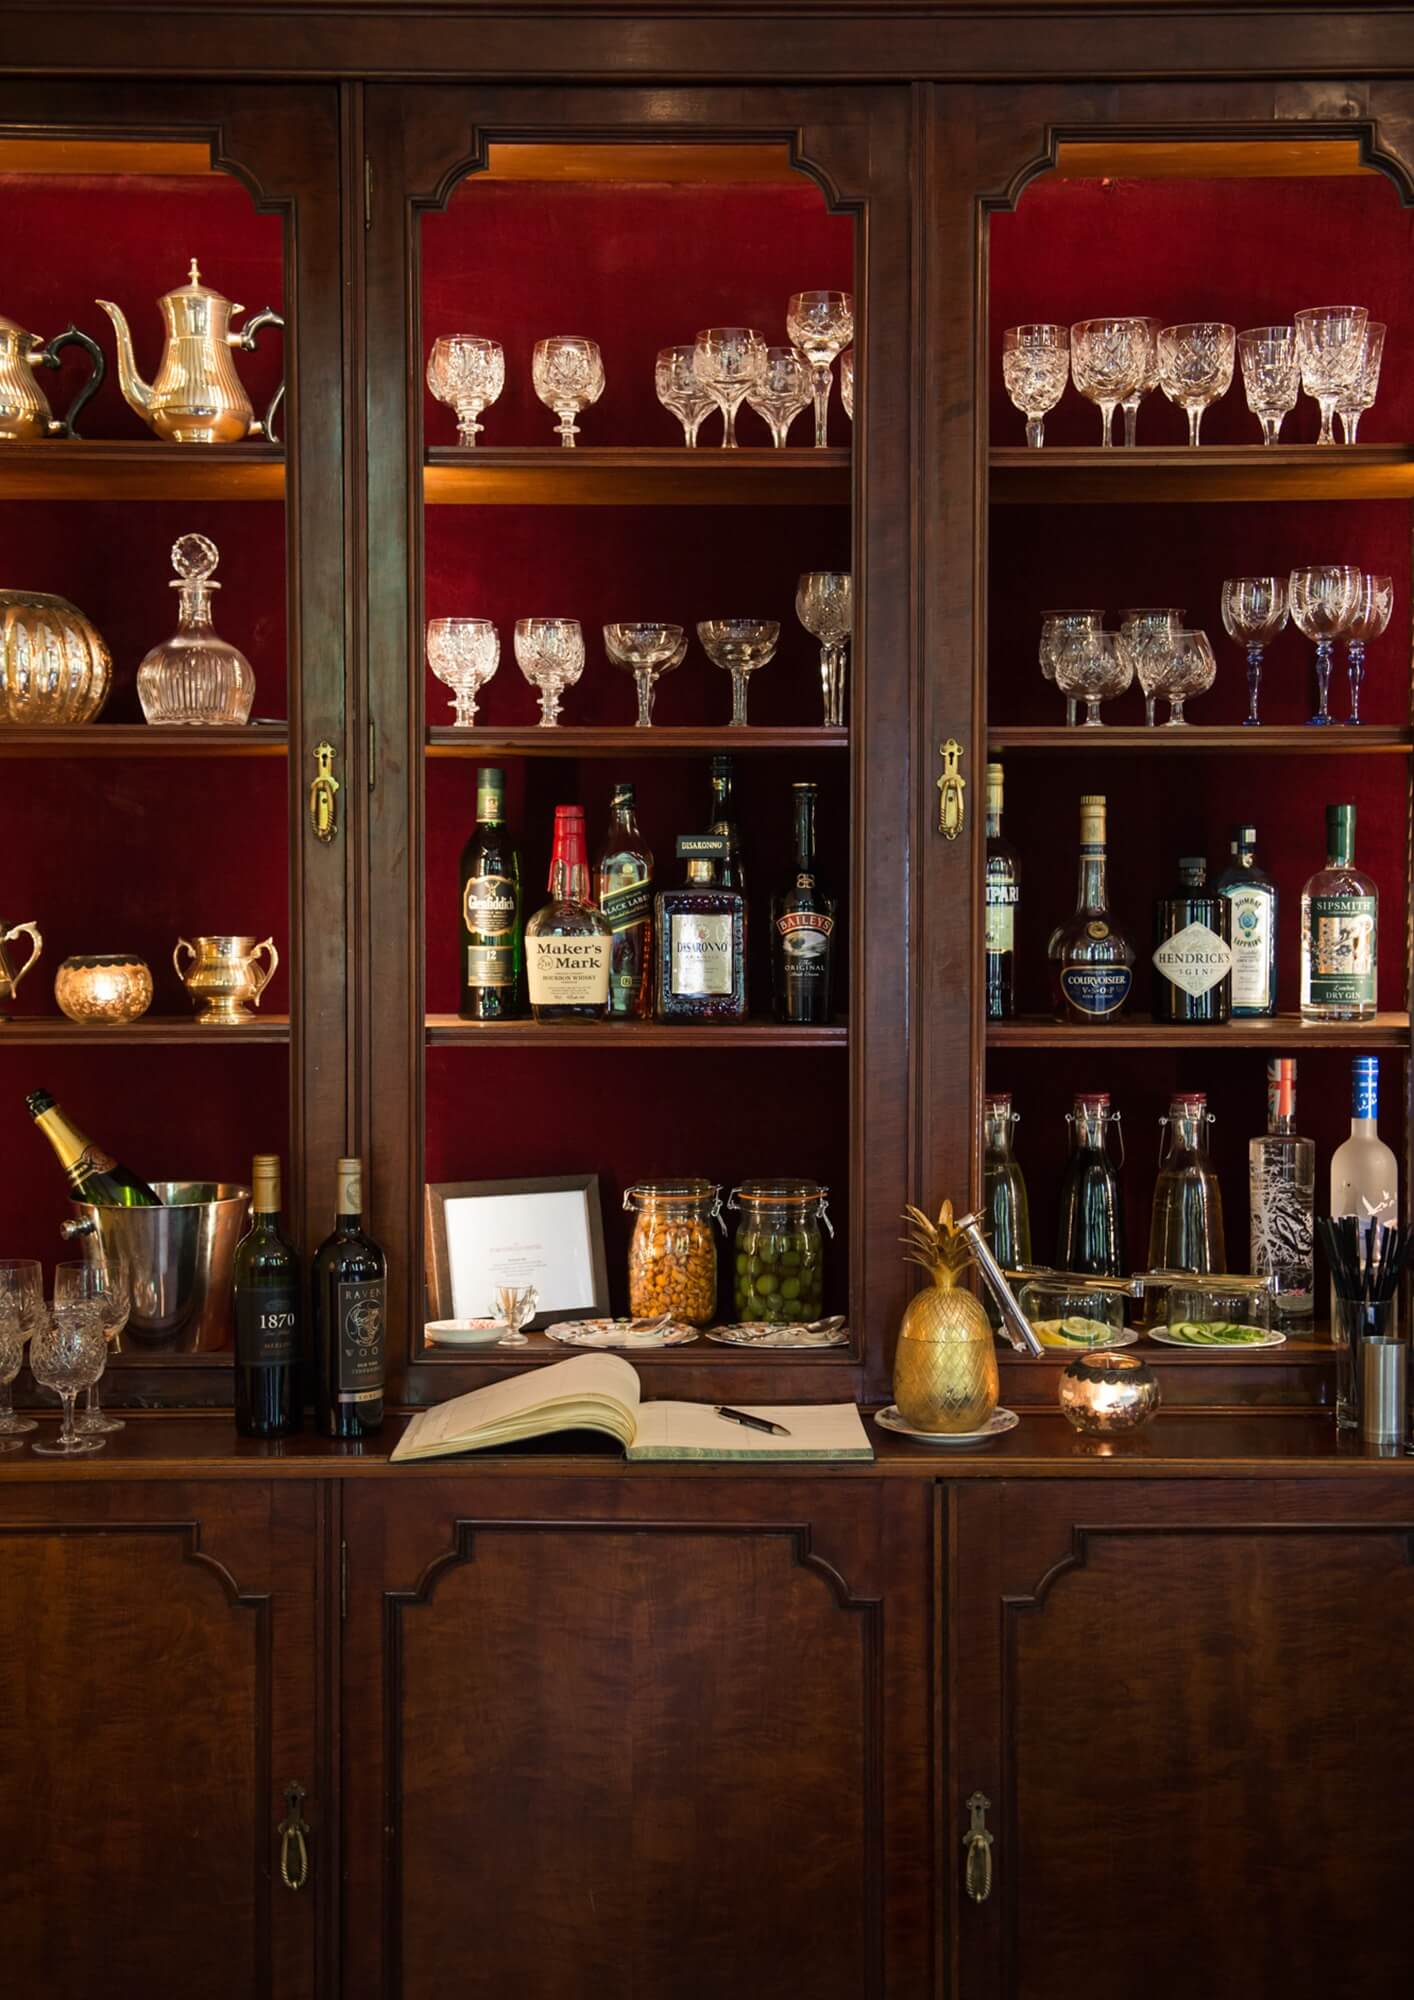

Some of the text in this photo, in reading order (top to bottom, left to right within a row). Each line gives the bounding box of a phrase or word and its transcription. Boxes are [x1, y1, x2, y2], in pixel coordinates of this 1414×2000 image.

[681, 841, 723, 849] DISARONNO
[985, 886, 1020, 902] PARI
[468, 895, 514, 910] Glenfiddich
[1235, 897, 1262, 910] BOMBAY
[1316, 902, 1371, 911] SIPSMITH
[780, 915, 830, 930] BAILEYS
[537, 944, 602, 954] Maker's
[486, 951, 497, 960] 12
[1159, 953, 1230, 964] HENDRICK'S
[556, 958, 601, 968] Mark
[1068, 976, 1126, 987] COURVOISIER
[1326, 991, 1361, 999] DRY GIN
[260, 1313, 295, 1329] 1870
